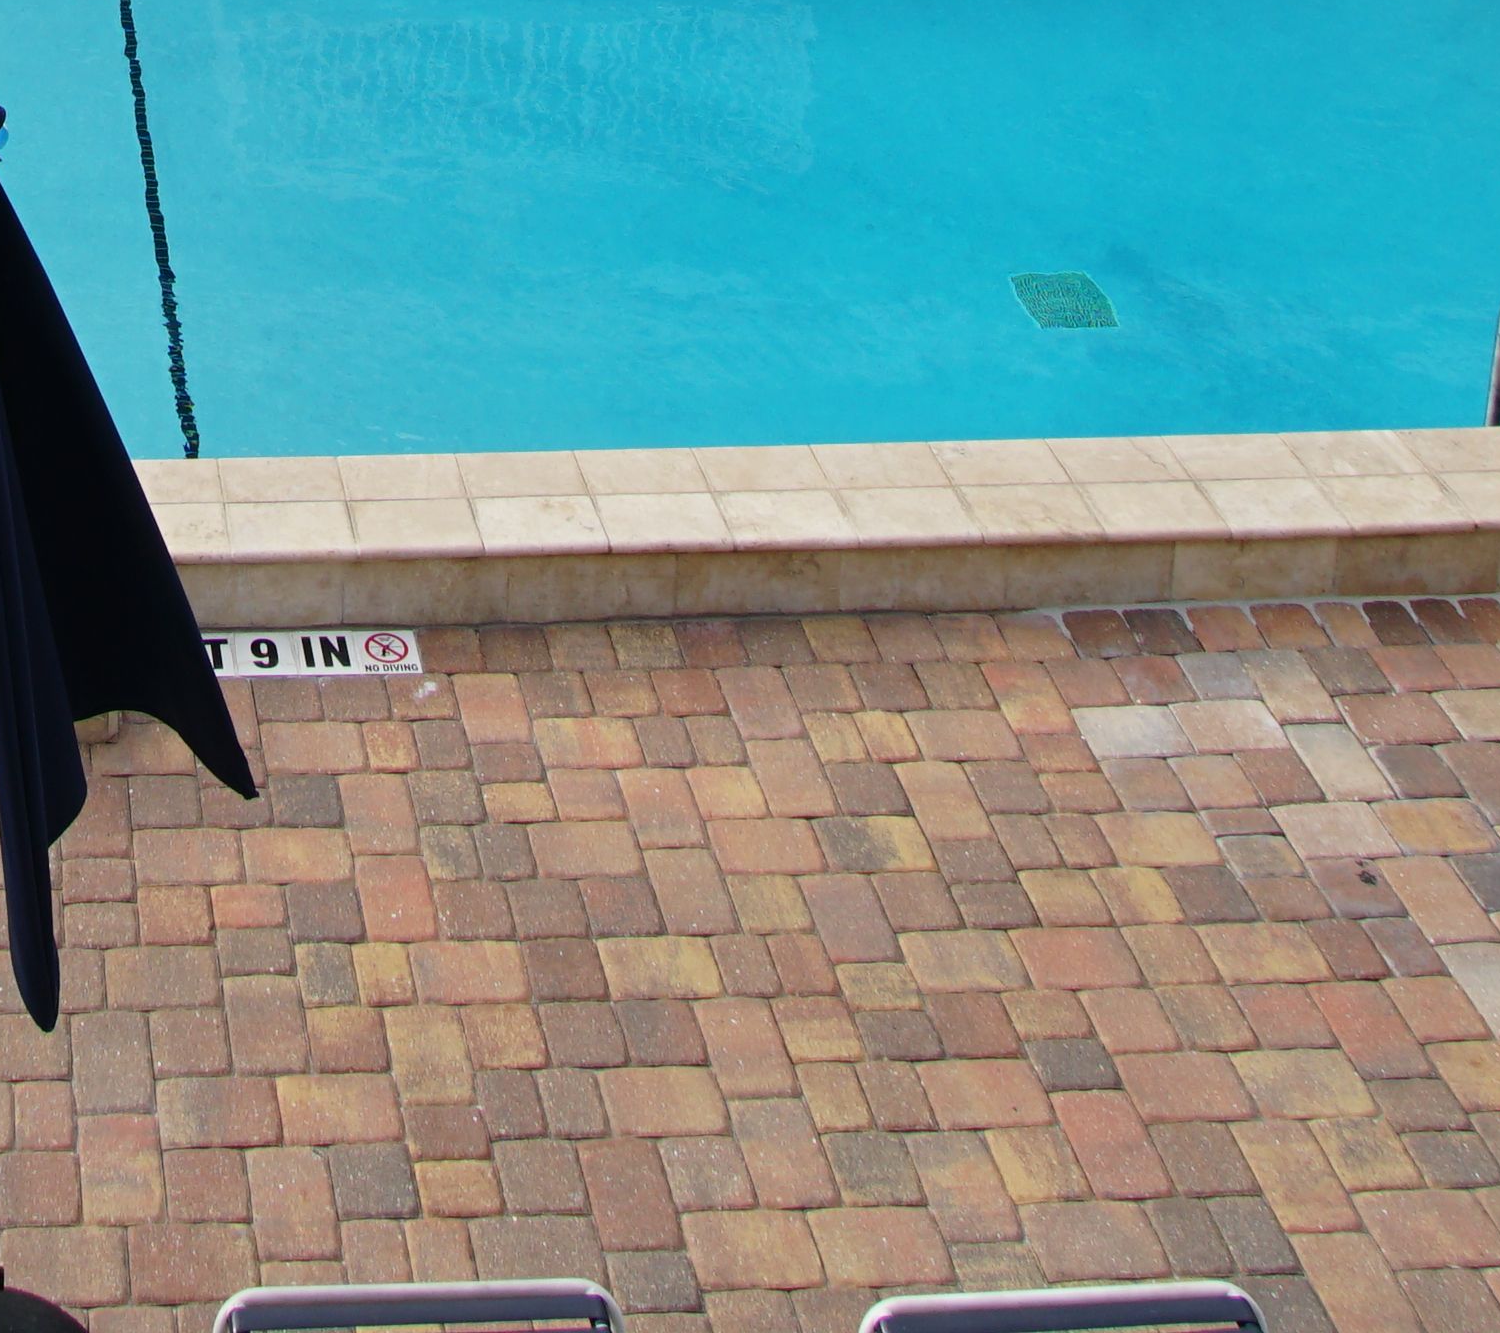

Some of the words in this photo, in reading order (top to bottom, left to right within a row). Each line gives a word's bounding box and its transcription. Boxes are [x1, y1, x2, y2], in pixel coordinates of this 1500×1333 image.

[200, 638, 228, 669] T
[250, 638, 279, 669] 9
[300, 636, 352, 668] IN
[365, 664, 380, 672] NO
[382, 664, 419, 672] DIVING
